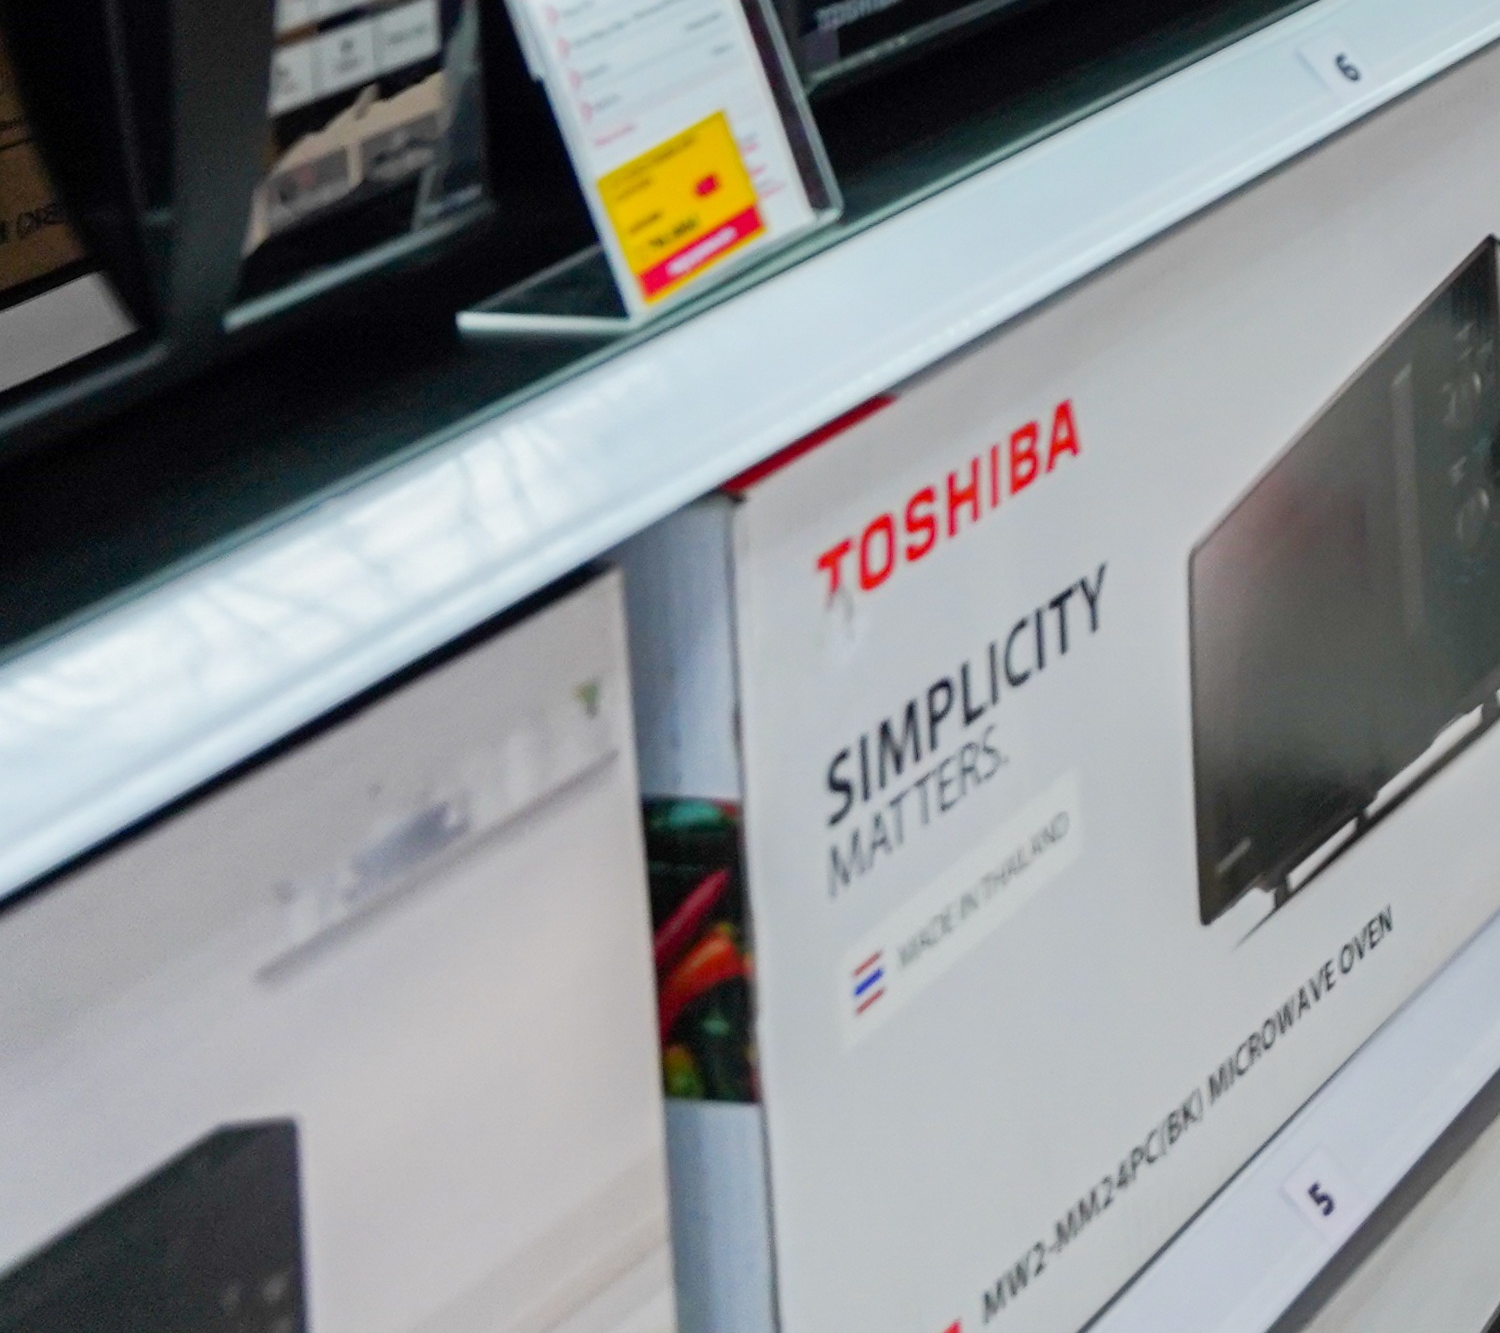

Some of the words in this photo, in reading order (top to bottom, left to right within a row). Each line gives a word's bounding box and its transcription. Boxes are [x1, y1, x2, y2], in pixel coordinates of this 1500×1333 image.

[816, 398, 1081, 613] TOSHIBA
[825, 562, 1109, 829] SIMPLICITY
[1206, 958, 1336, 1105] MICROWAVE
[1337, 904, 1395, 976] OVEN
[1308, 1181, 1336, 1217] 5
